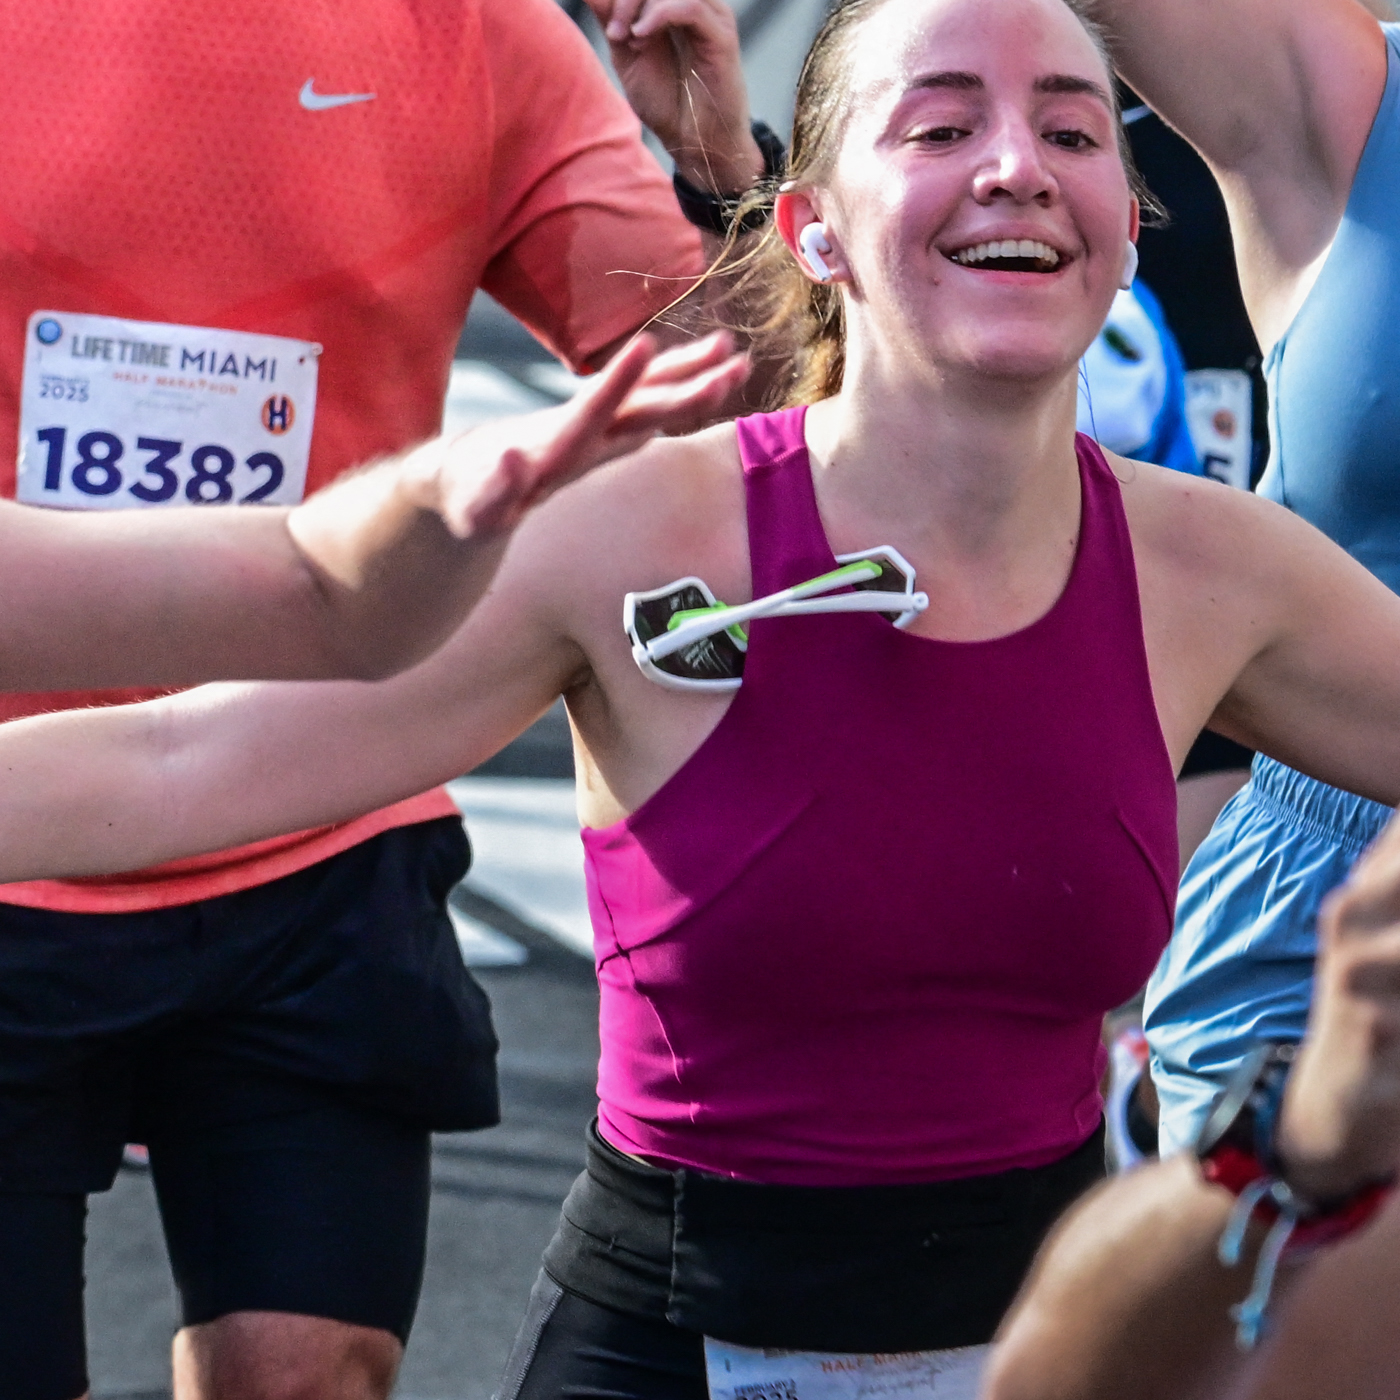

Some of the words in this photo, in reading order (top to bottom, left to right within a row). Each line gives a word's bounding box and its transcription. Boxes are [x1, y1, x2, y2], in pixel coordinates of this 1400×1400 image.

[180, 346, 278, 383] MIAMI
[39, 382, 89, 403] 2025
[36, 426, 285, 507] 18382
